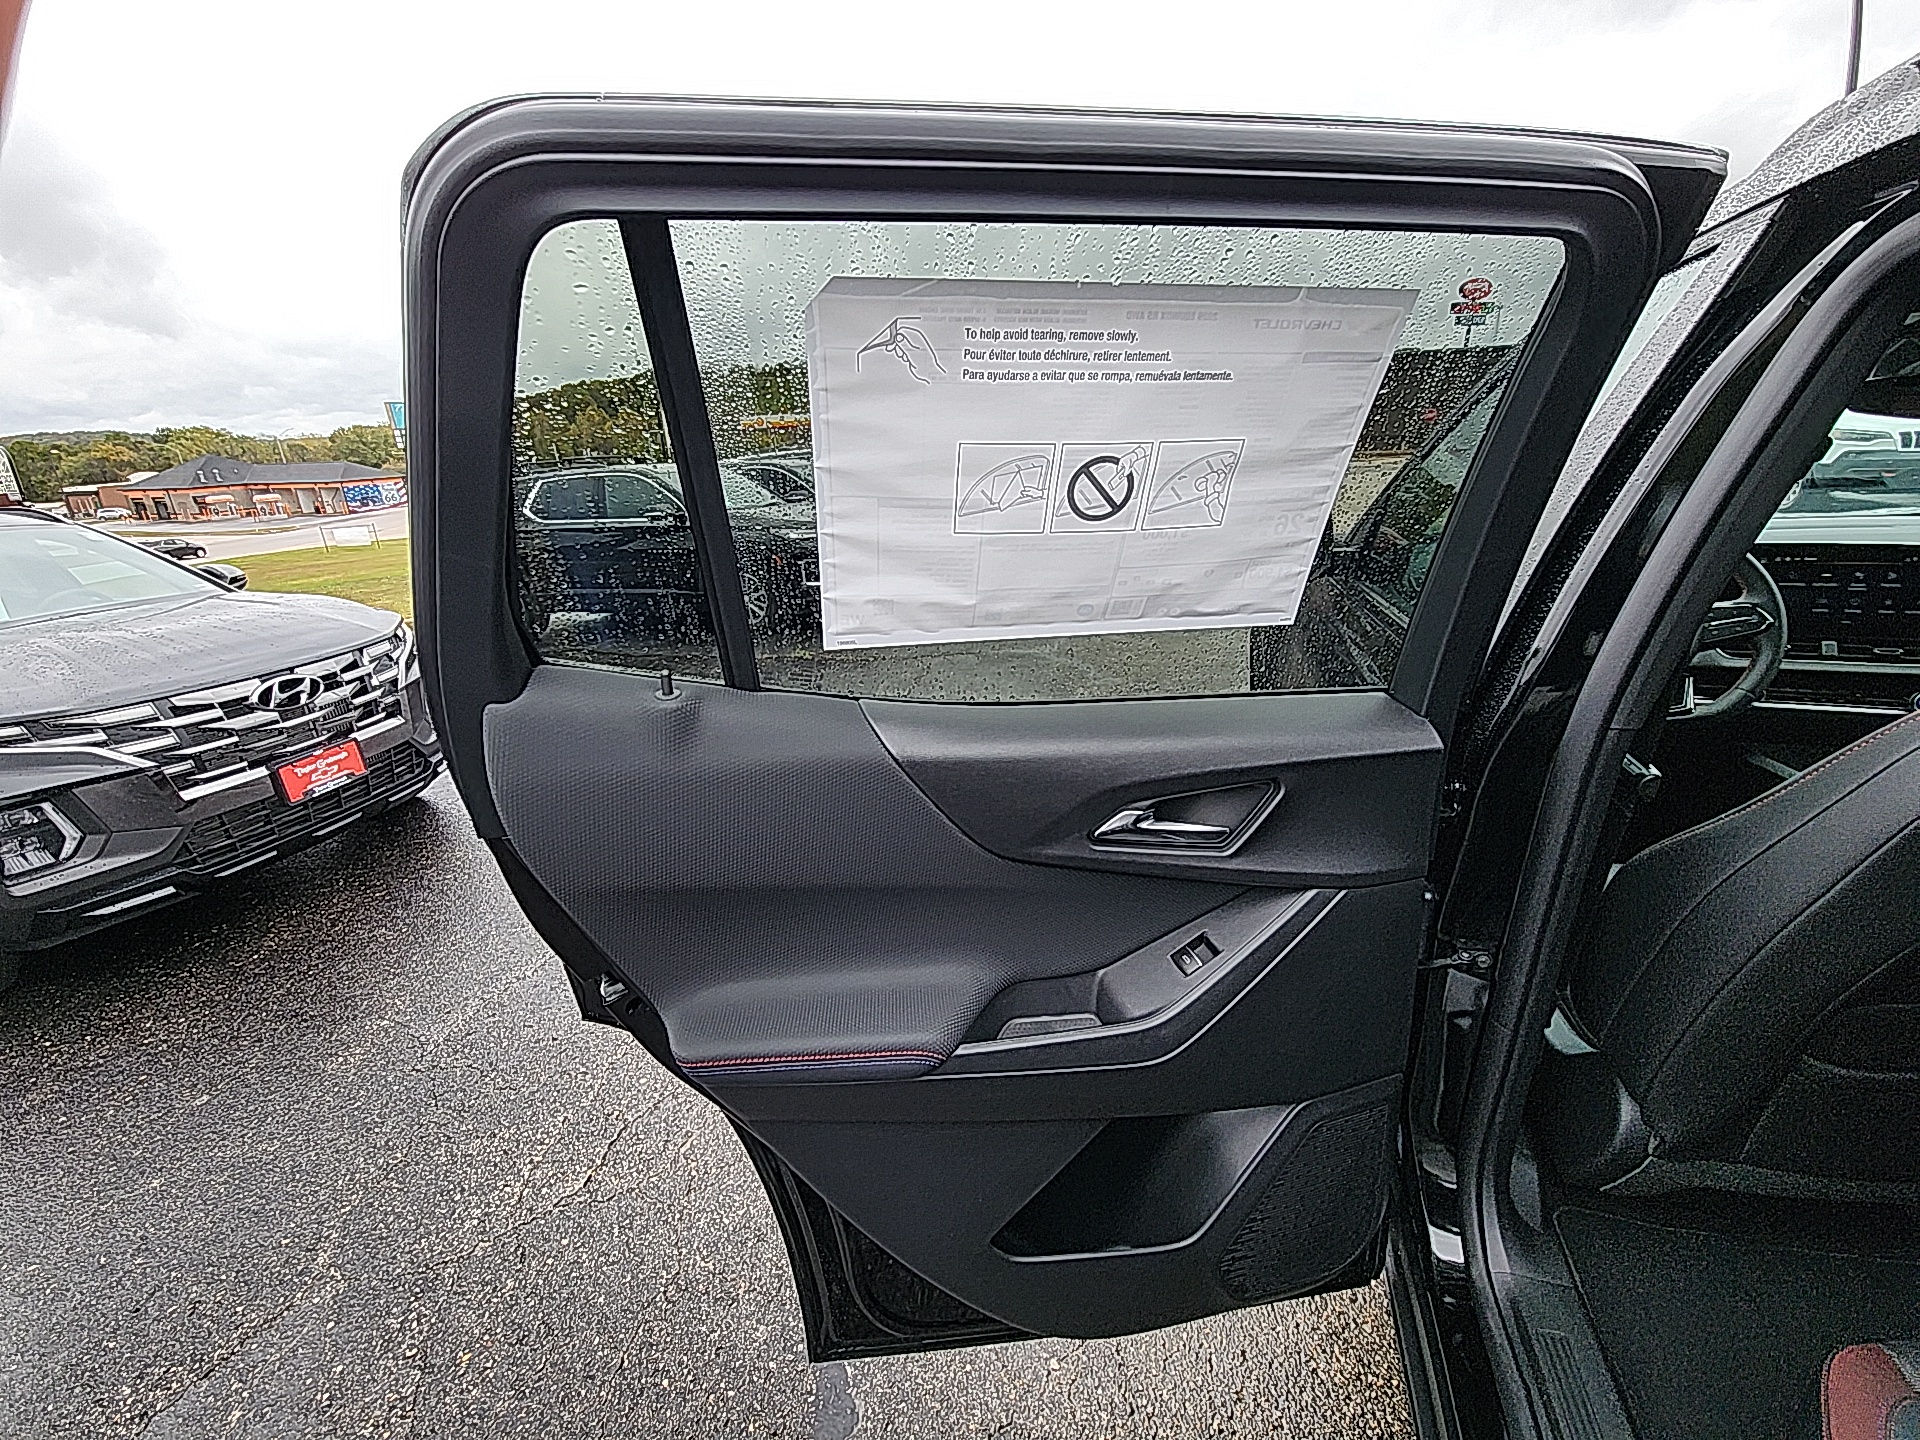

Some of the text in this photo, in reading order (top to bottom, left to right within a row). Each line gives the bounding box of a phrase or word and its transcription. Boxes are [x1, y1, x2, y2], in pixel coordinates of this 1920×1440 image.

[964, 327, 1139, 344] To help avoid tearing, remove slowly.
[963, 348, 1172, 363] Pour éviter toute déchirure, retirer lentement.
[962, 368, 1234, 384] Para ayudarse a evitar que se rompa, remuévala lentamente.
[384, 492, 398, 503] 66
